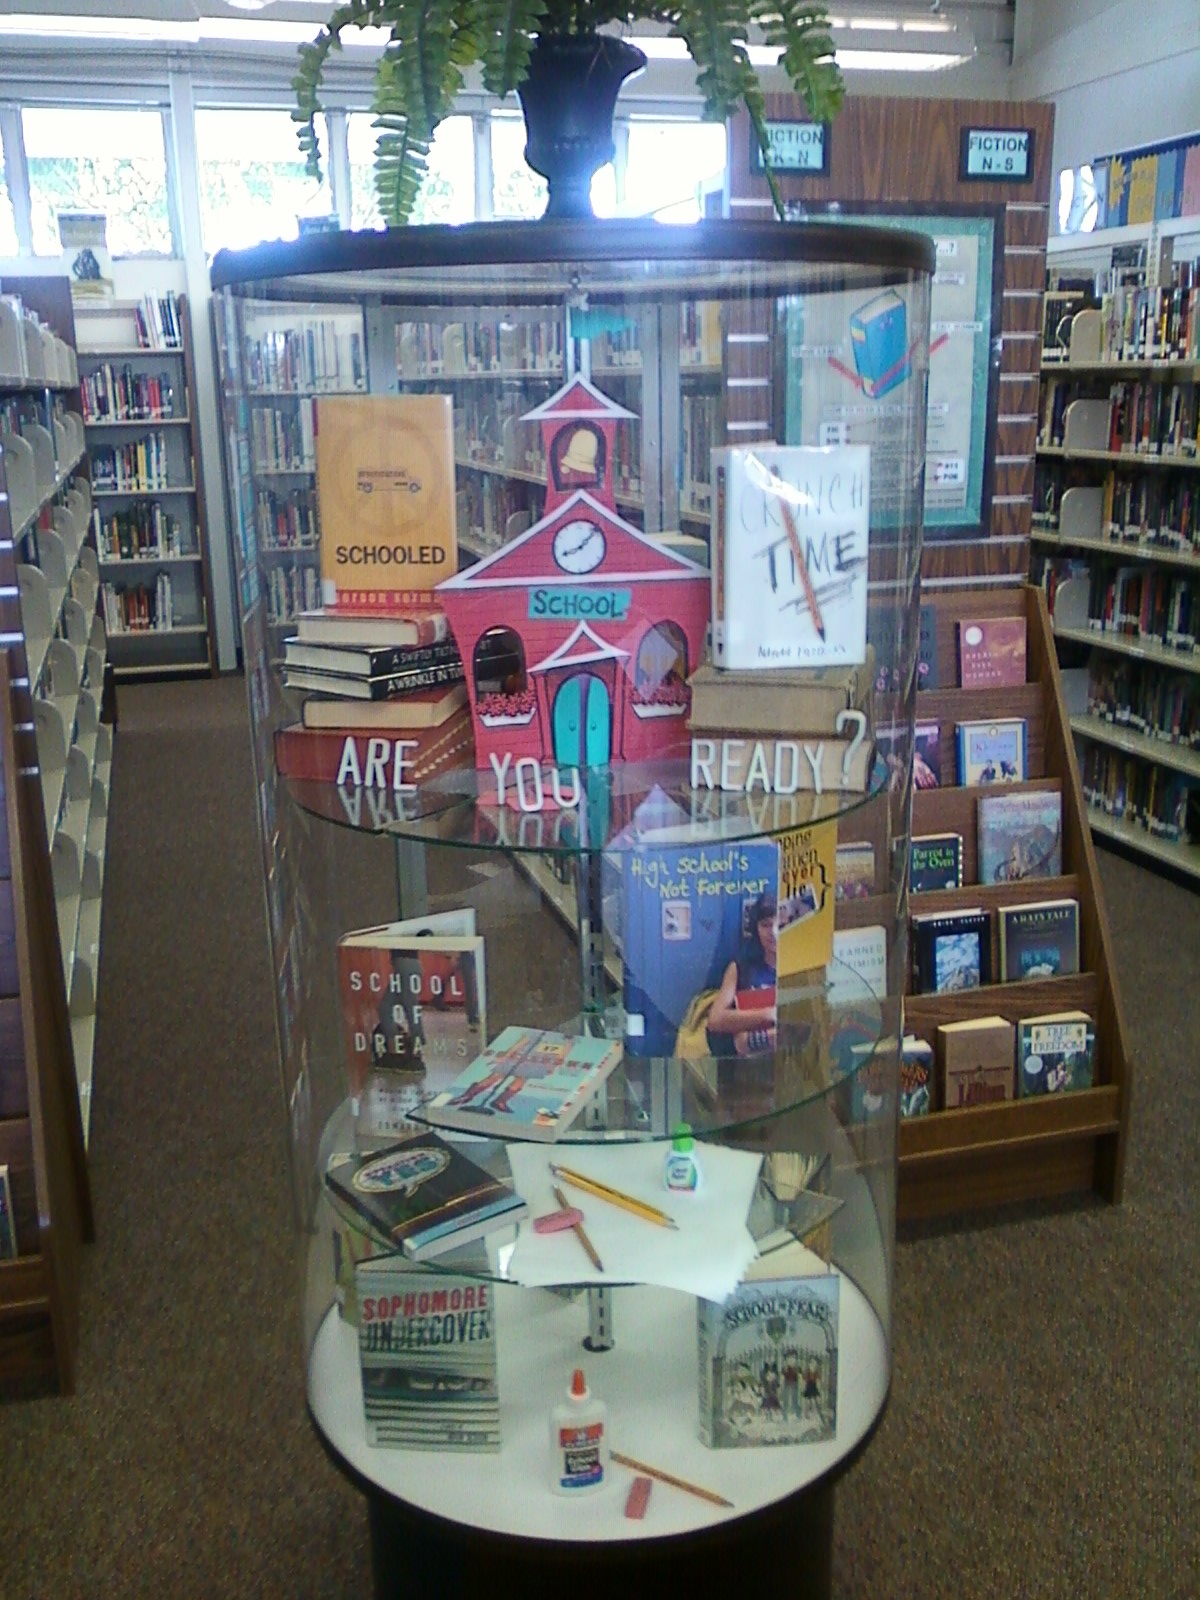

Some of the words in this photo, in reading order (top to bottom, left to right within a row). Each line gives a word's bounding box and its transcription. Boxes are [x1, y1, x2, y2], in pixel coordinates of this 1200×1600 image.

[766, 129, 824, 144] ICTION
[969, 136, 1028, 151] FICTION
[798, 149, 809, 164] N
[982, 157, 993, 170] N
[1004, 157, 1014, 171] S
[336, 545, 446, 565] SCHOOLED
[752, 531, 867, 594] TIME
[533, 589, 623, 618] SCHOOL
[387, 679, 397, 692] A
[396, 674, 435, 690] WRINKLE
[337, 736, 420, 791] ARE
[488, 751, 581, 812] YOU
[631, 855, 670, 889] High
[677, 850, 749, 874] School's
[660, 877, 690, 899] Not
[696, 878, 770, 896] Forever
[349, 970, 463, 996] SCHOOL
[391, 1004, 423, 1025] OF
[354, 1032, 468, 1058] DREAMS
[362, 1285, 488, 1322] SOPHOMORE
[362, 1310, 490, 1350] UNDERCOVER
